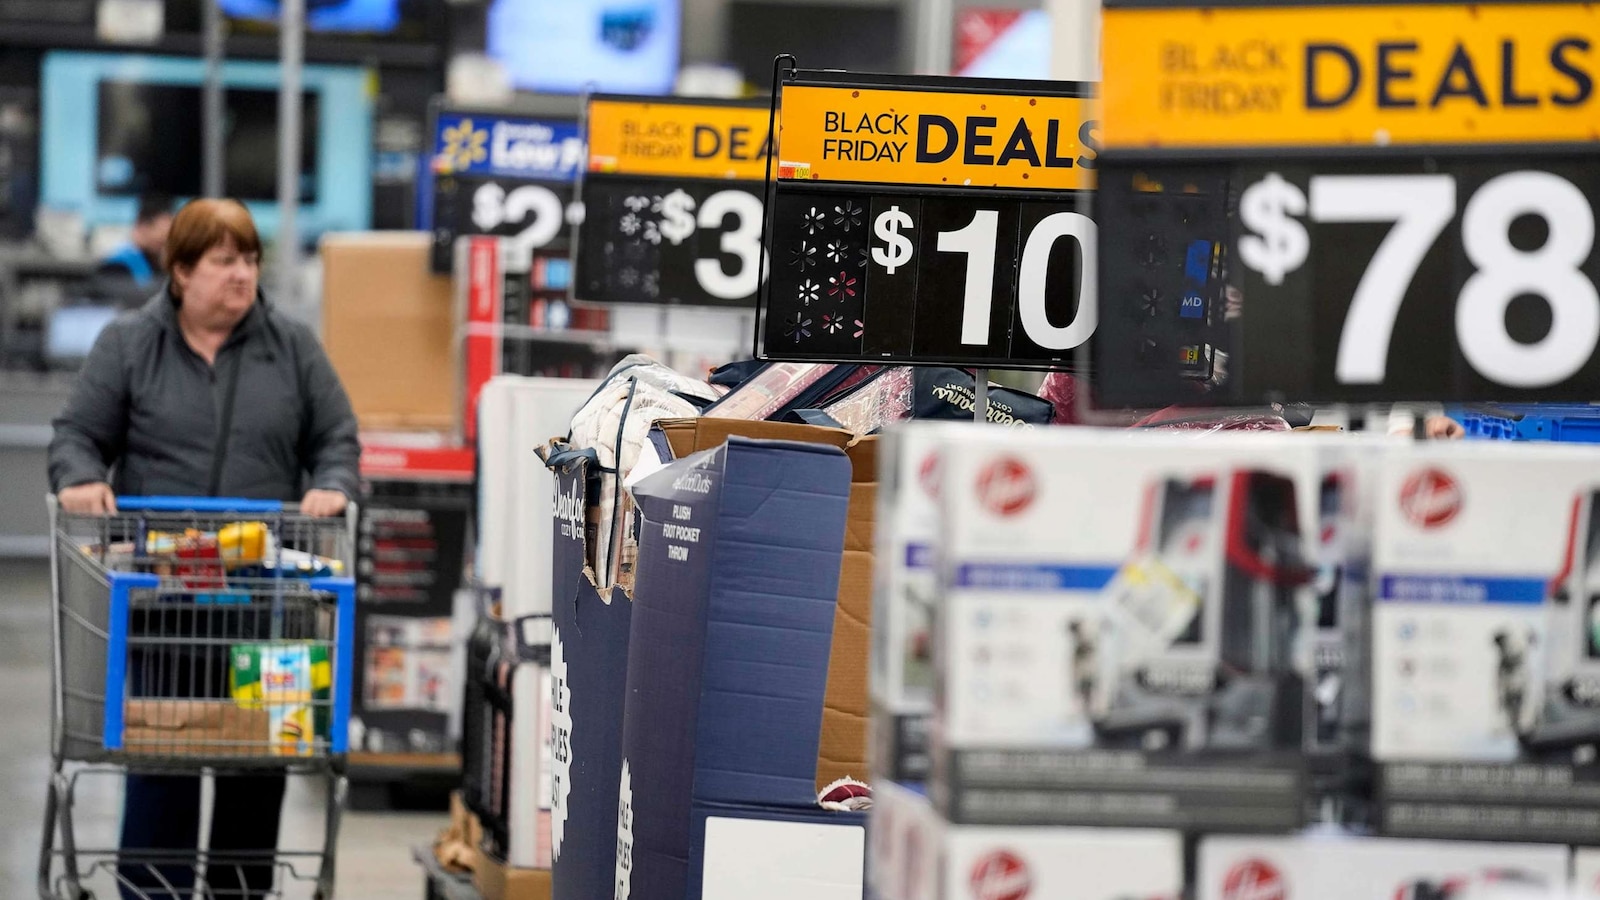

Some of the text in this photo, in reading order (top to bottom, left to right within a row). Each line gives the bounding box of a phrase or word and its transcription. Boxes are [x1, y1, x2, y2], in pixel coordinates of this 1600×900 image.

[1161, 41, 1286, 71] BLACK
[1303, 38, 1594, 109] DEALS
[1160, 80, 1286, 114] FRIDAY
[824, 111, 910, 135] BLACK
[822, 138, 909, 162] FRIDAY
[1237, 170, 1600, 389] $78
[672, 504, 692, 520] PLUSH
[662, 523, 701, 542] FOOT POCKET
[668, 544, 689, 561] THROW
